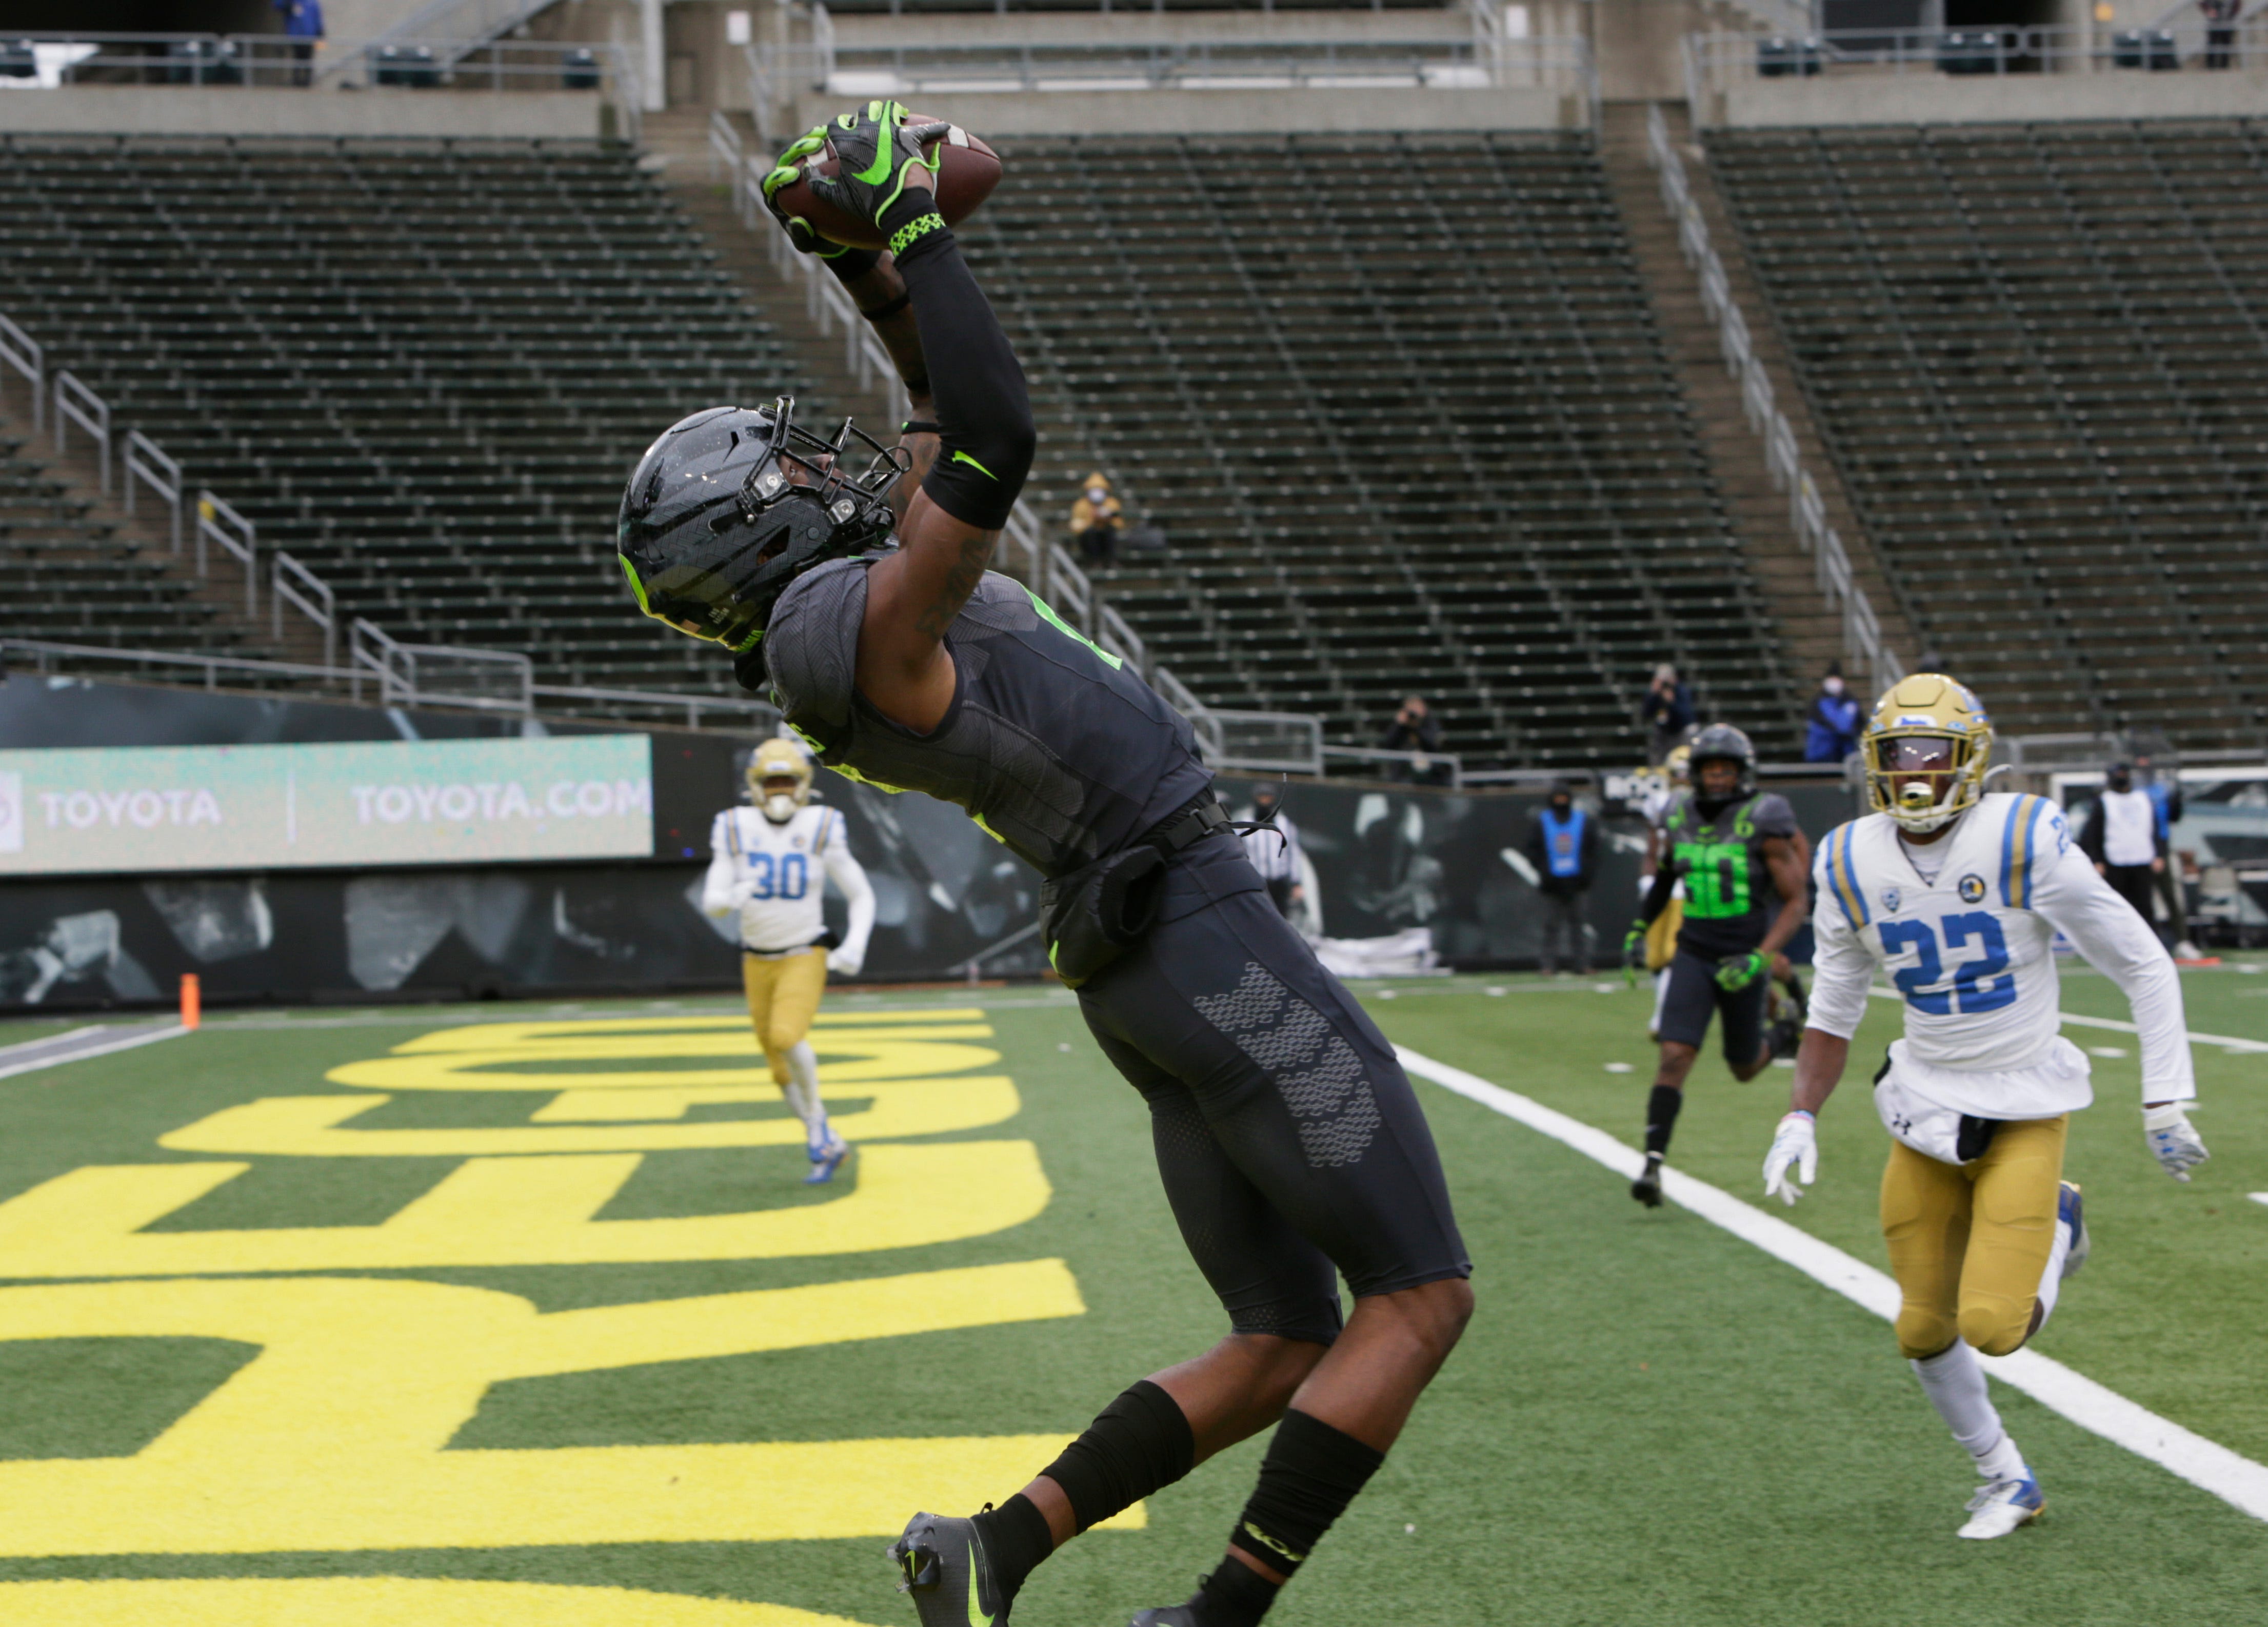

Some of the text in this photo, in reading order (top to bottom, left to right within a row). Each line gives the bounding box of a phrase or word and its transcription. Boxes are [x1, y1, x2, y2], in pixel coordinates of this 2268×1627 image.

[41, 788, 223, 829] TOYOTA
[352, 778, 651, 824] TOYOTA.COM
[748, 851, 808, 900] 30
[1674, 842, 1749, 918] 30
[1878, 910, 2017, 1015] 22
